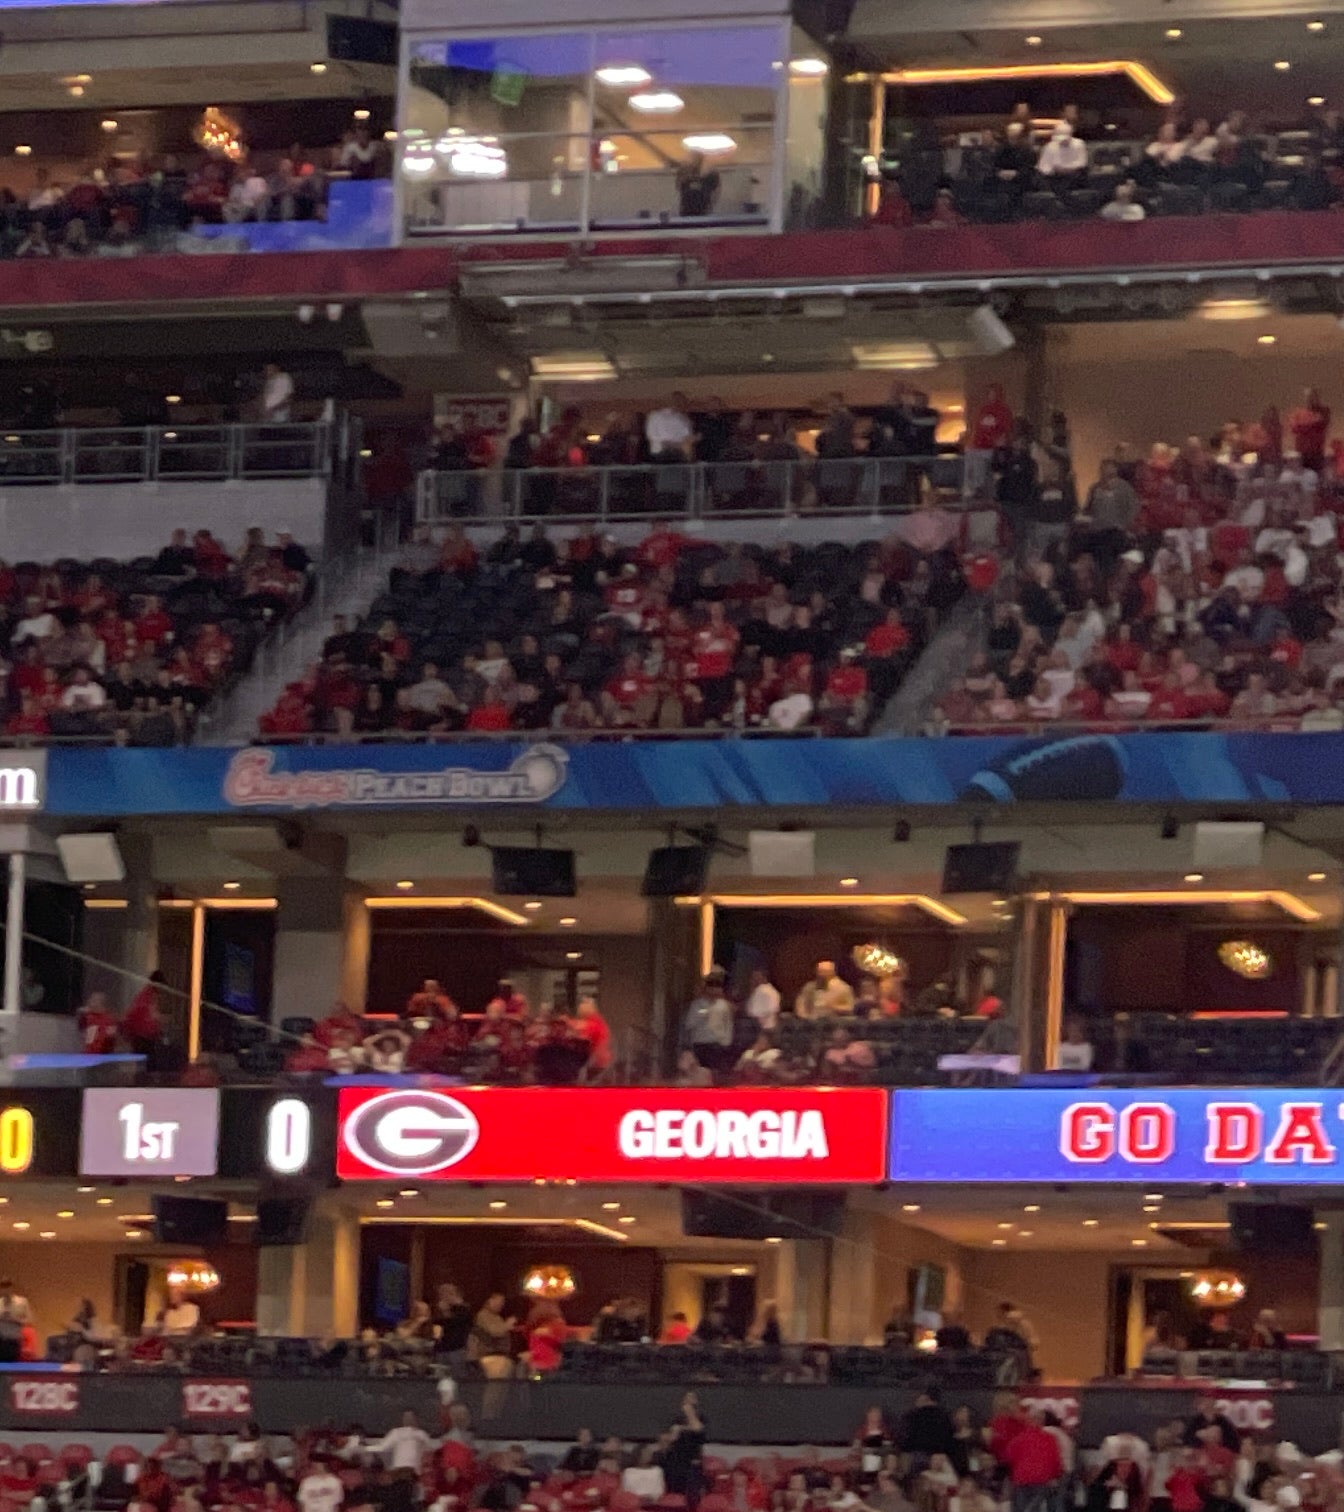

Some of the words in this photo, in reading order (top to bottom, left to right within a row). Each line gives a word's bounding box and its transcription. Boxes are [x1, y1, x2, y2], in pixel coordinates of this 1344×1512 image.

[118, 1101, 180, 1161] 1ST
[267, 1097, 311, 1174] 0
[618, 1109, 830, 1159] GEORGIA
[1059, 1101, 1176, 1164] GO
[1204, 1101, 1344, 1164] DA
[11, 1381, 78, 1411] 128C
[182, 1384, 251, 1413] 129C
